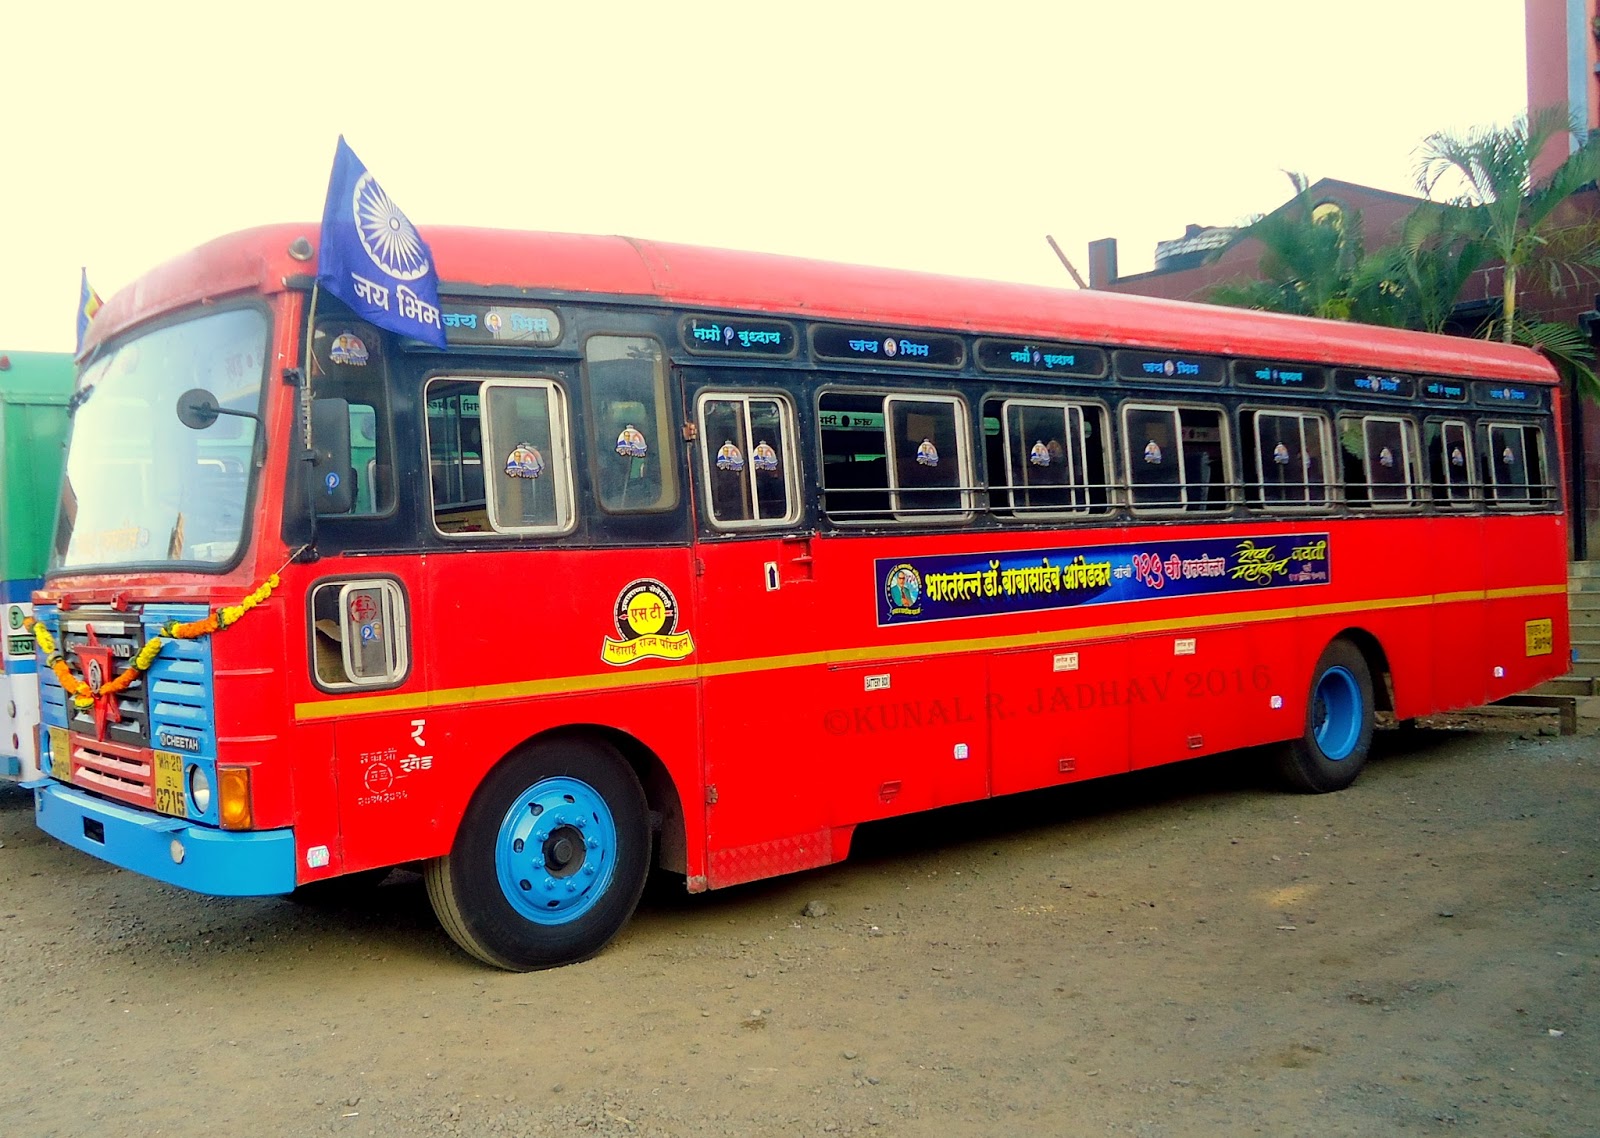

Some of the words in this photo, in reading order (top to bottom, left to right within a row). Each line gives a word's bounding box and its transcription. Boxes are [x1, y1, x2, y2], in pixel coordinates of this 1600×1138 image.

[351, 271, 389, 311] जय
[396, 284, 441, 330] भिम
[441, 313, 477, 329] जय
[693, 324, 720, 341] नमो
[849, 339, 878, 353] जय
[900, 339, 929, 356] भिम
[925, 571, 982, 601] भारतरत्न
[1002, 557, 1061, 596] बाबासाहेब
[1063, 555, 1112, 591] आंबेडकर
[166, 735, 199, 751] CHEETAH
